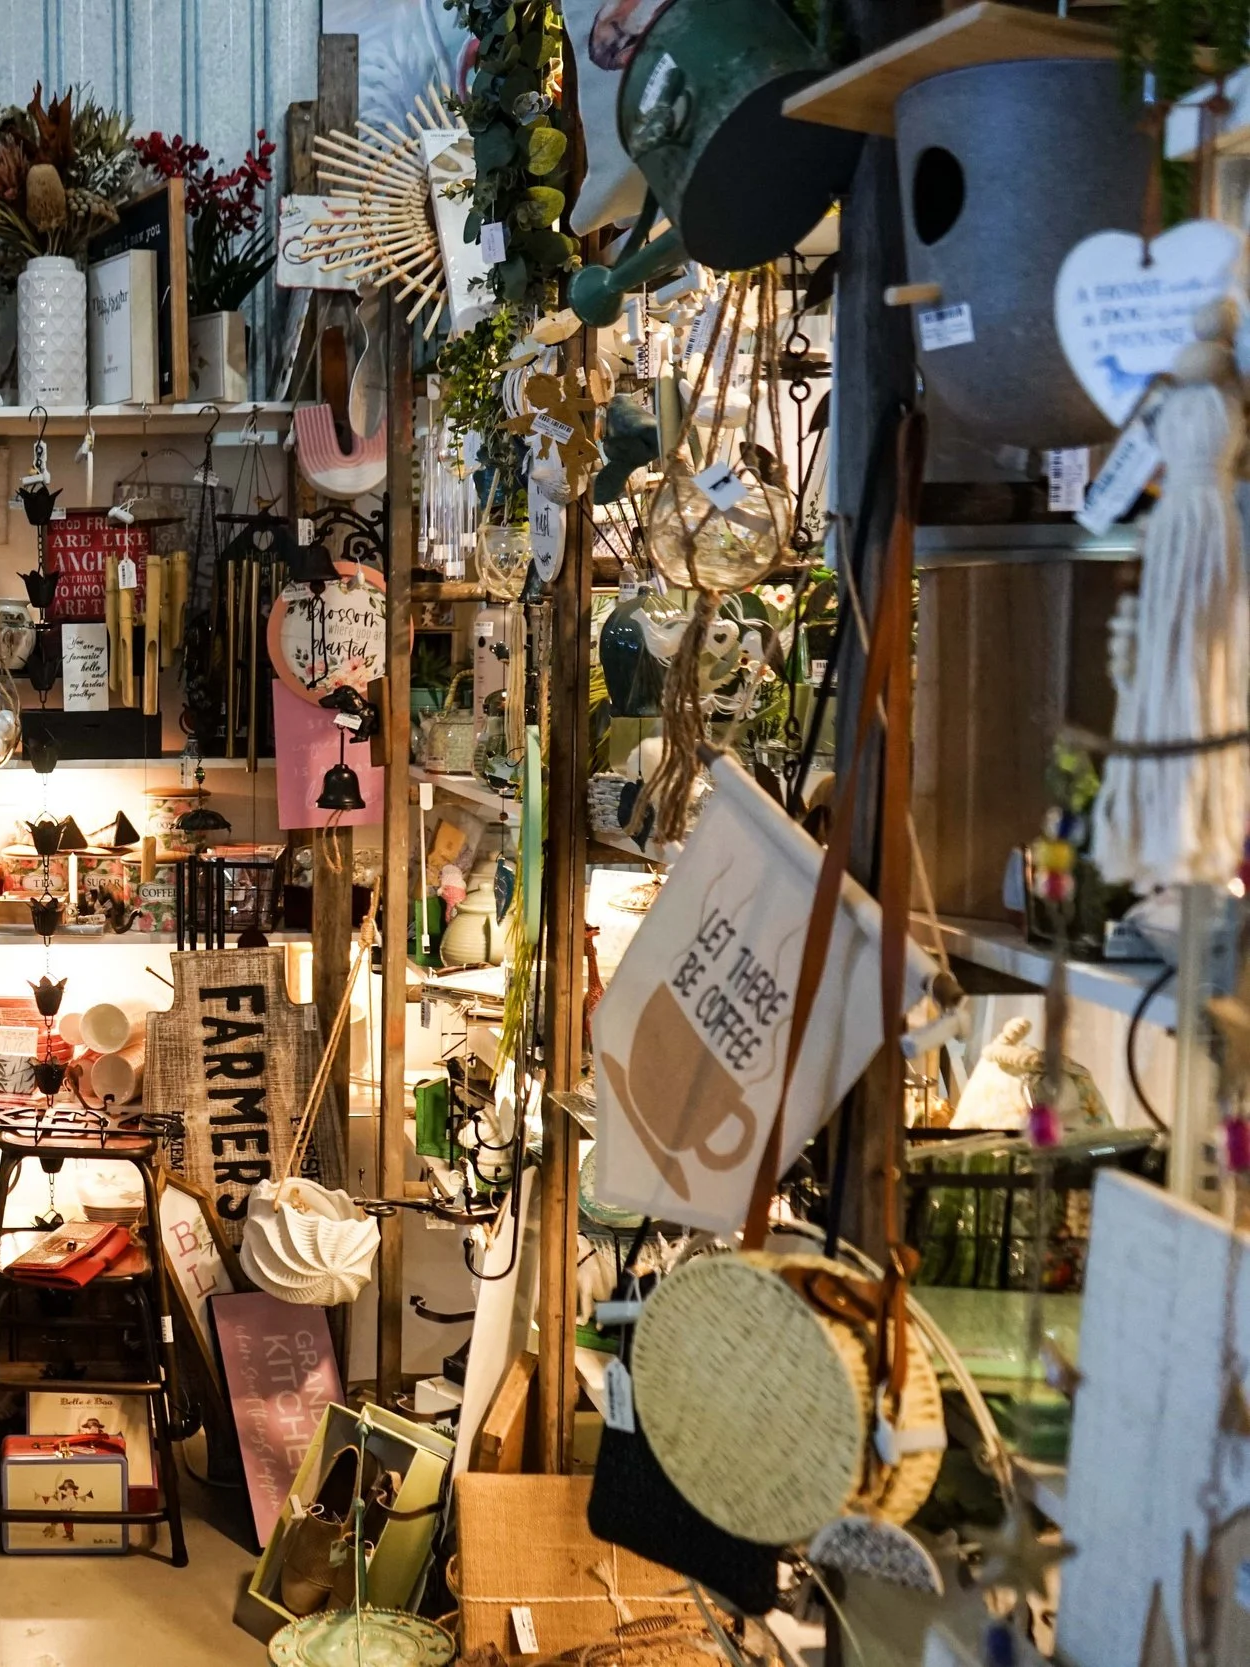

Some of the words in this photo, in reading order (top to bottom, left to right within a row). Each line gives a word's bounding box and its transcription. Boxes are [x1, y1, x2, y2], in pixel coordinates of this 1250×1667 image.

[146, 222, 161, 243] you
[53, 519, 81, 530] GOOD
[52, 534, 92, 548] ARE
[102, 532, 148, 547] LIKE
[54, 599, 87, 616] ARE
[2, 612, 26, 621] TEA
[328, 622, 354, 637] where
[355, 628, 371, 641] you
[67, 636, 84, 650] You
[94, 646, 105, 655] my
[66, 652, 100, 664] favourite
[80, 661, 101, 672] hello
[91, 670, 107, 679] and
[69, 682, 80, 692] my
[68, 689, 91, 701] goodbye
[86, 877, 121, 888] SUGAR
[141, 887, 176, 898] COFFE
[697, 907, 737, 963] LET
[726, 945, 790, 1027] THERE
[671, 951, 707, 998] BE
[695, 984, 763, 1071] COFFEE
[198, 985, 272, 1221] FARMERS
[93, 1397, 113, 1406] Boo
